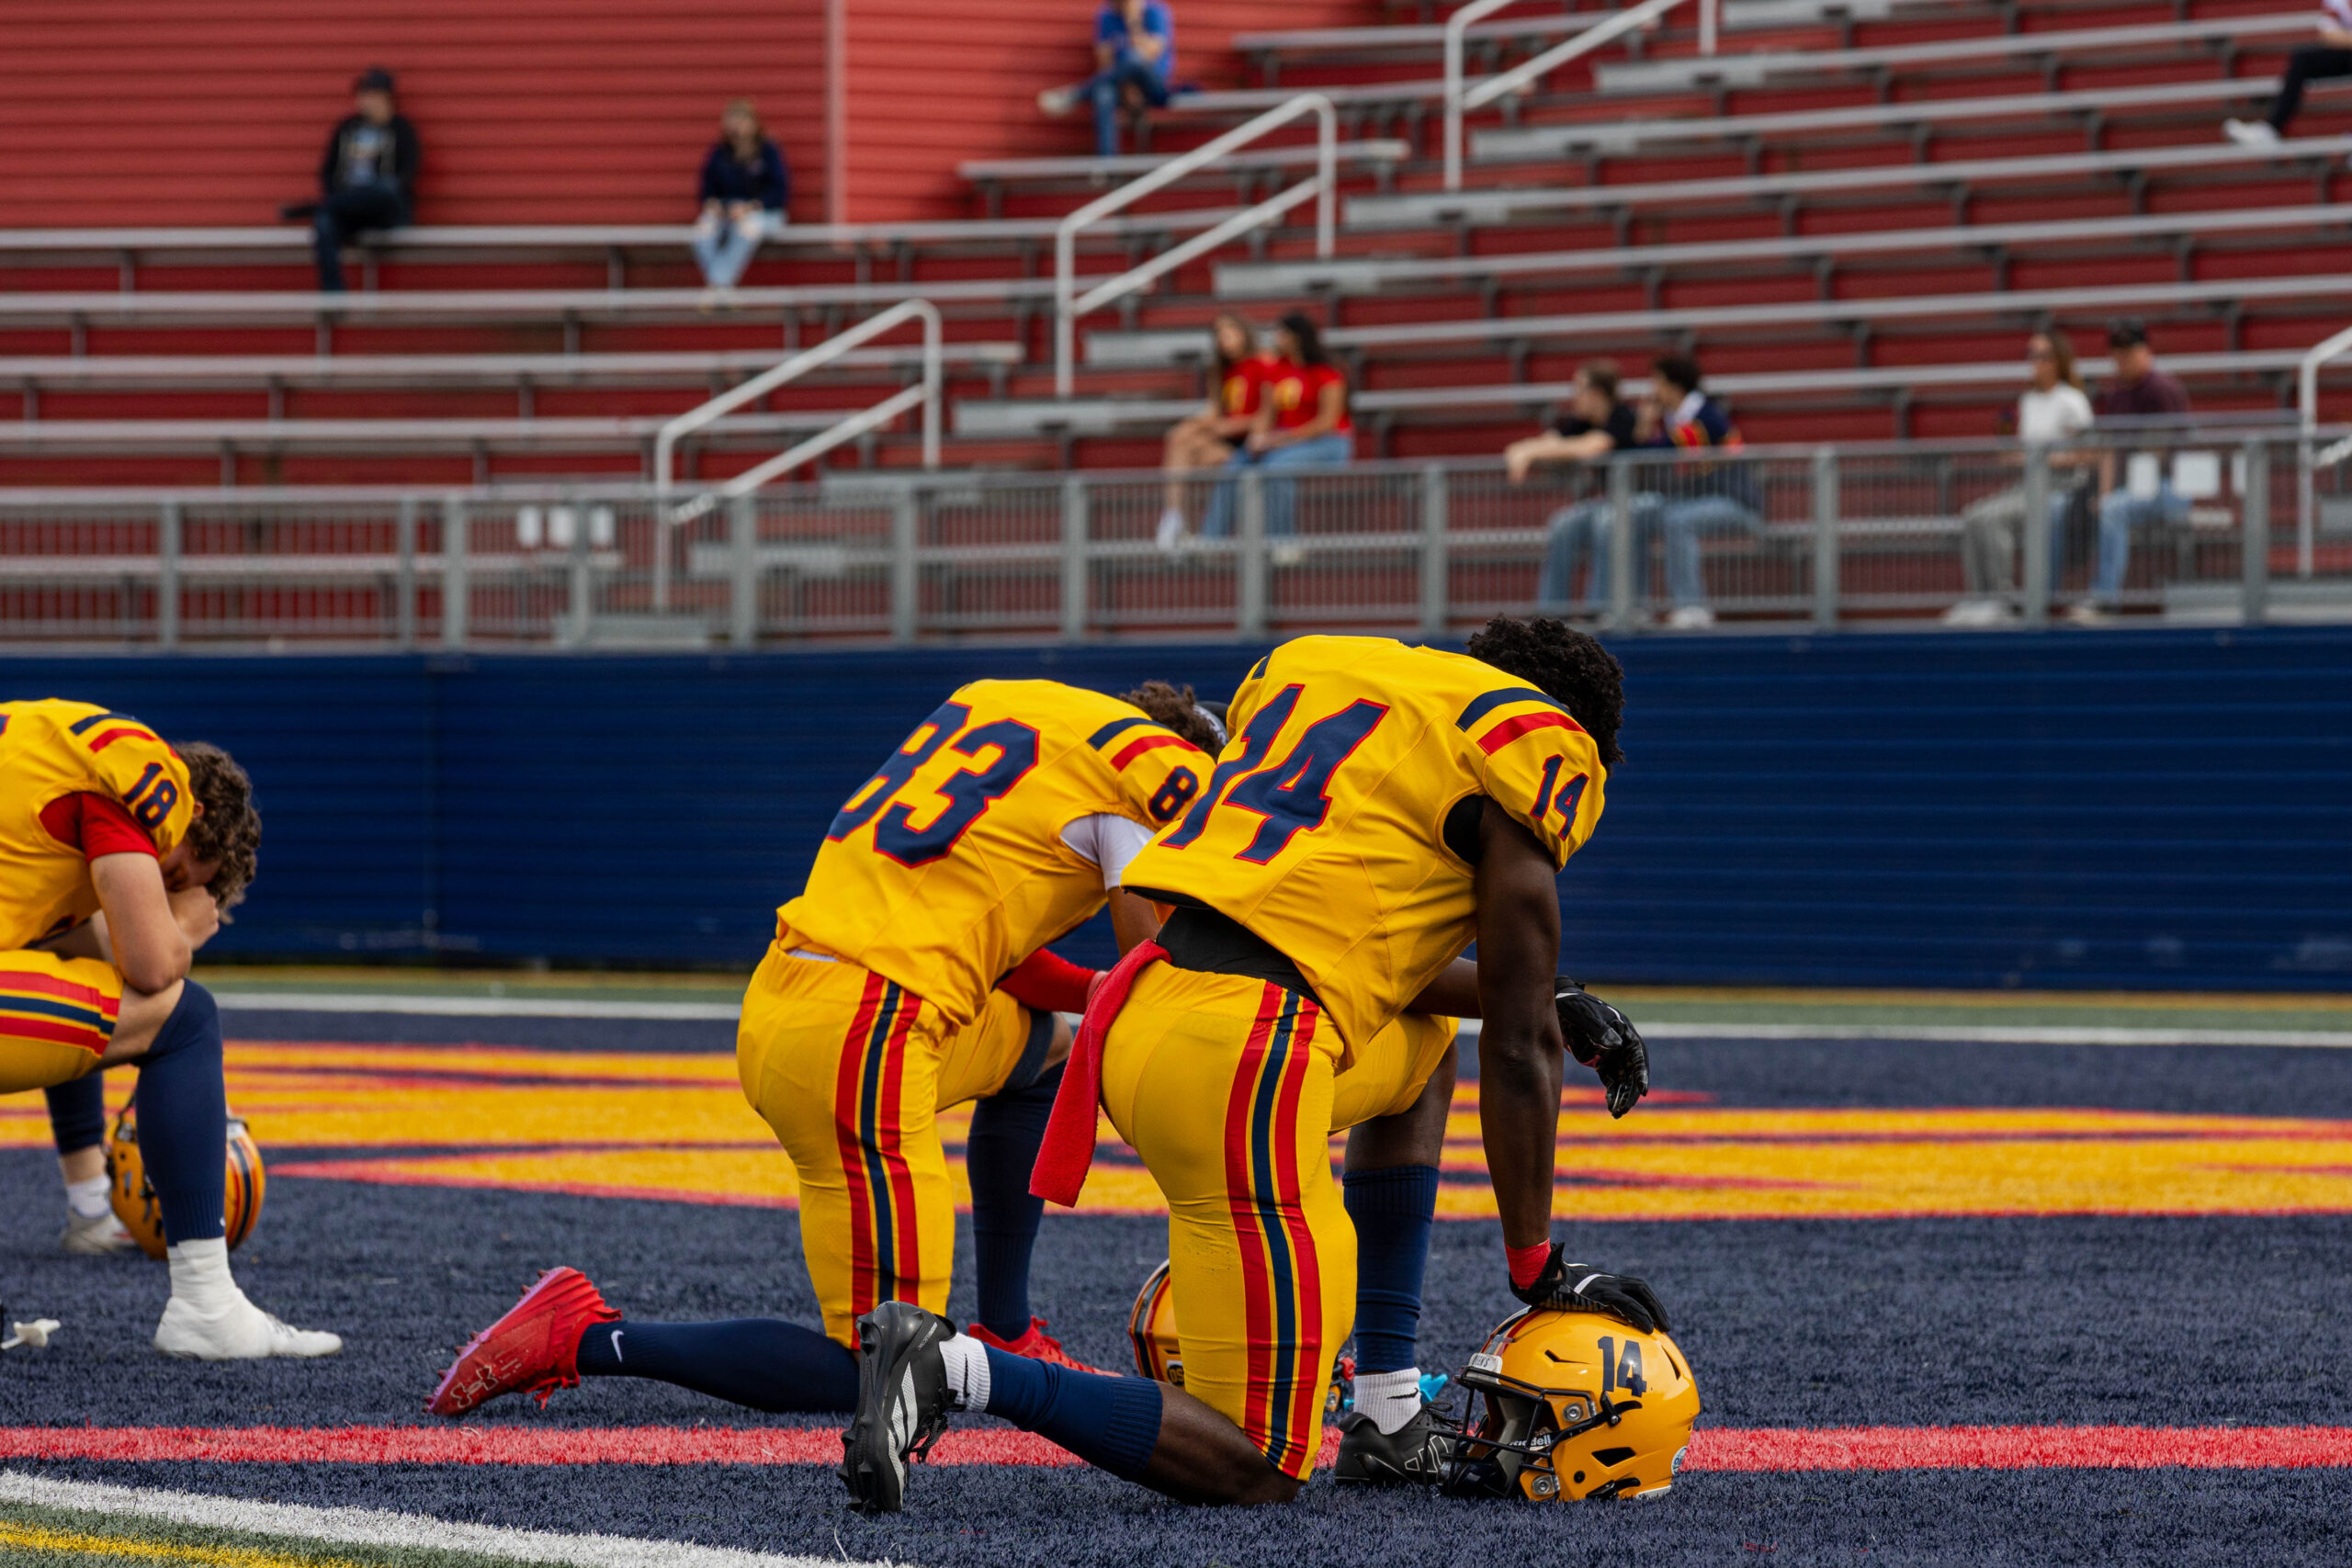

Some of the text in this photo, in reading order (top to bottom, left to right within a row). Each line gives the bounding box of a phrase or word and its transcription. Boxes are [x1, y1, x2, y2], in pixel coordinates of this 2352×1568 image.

[122, 762, 178, 829] 18
[827, 700, 1040, 869] 83
[1159, 683, 1390, 865] 14
[1531, 754, 1589, 841] 14
[1598, 1336, 1647, 1398] 14
